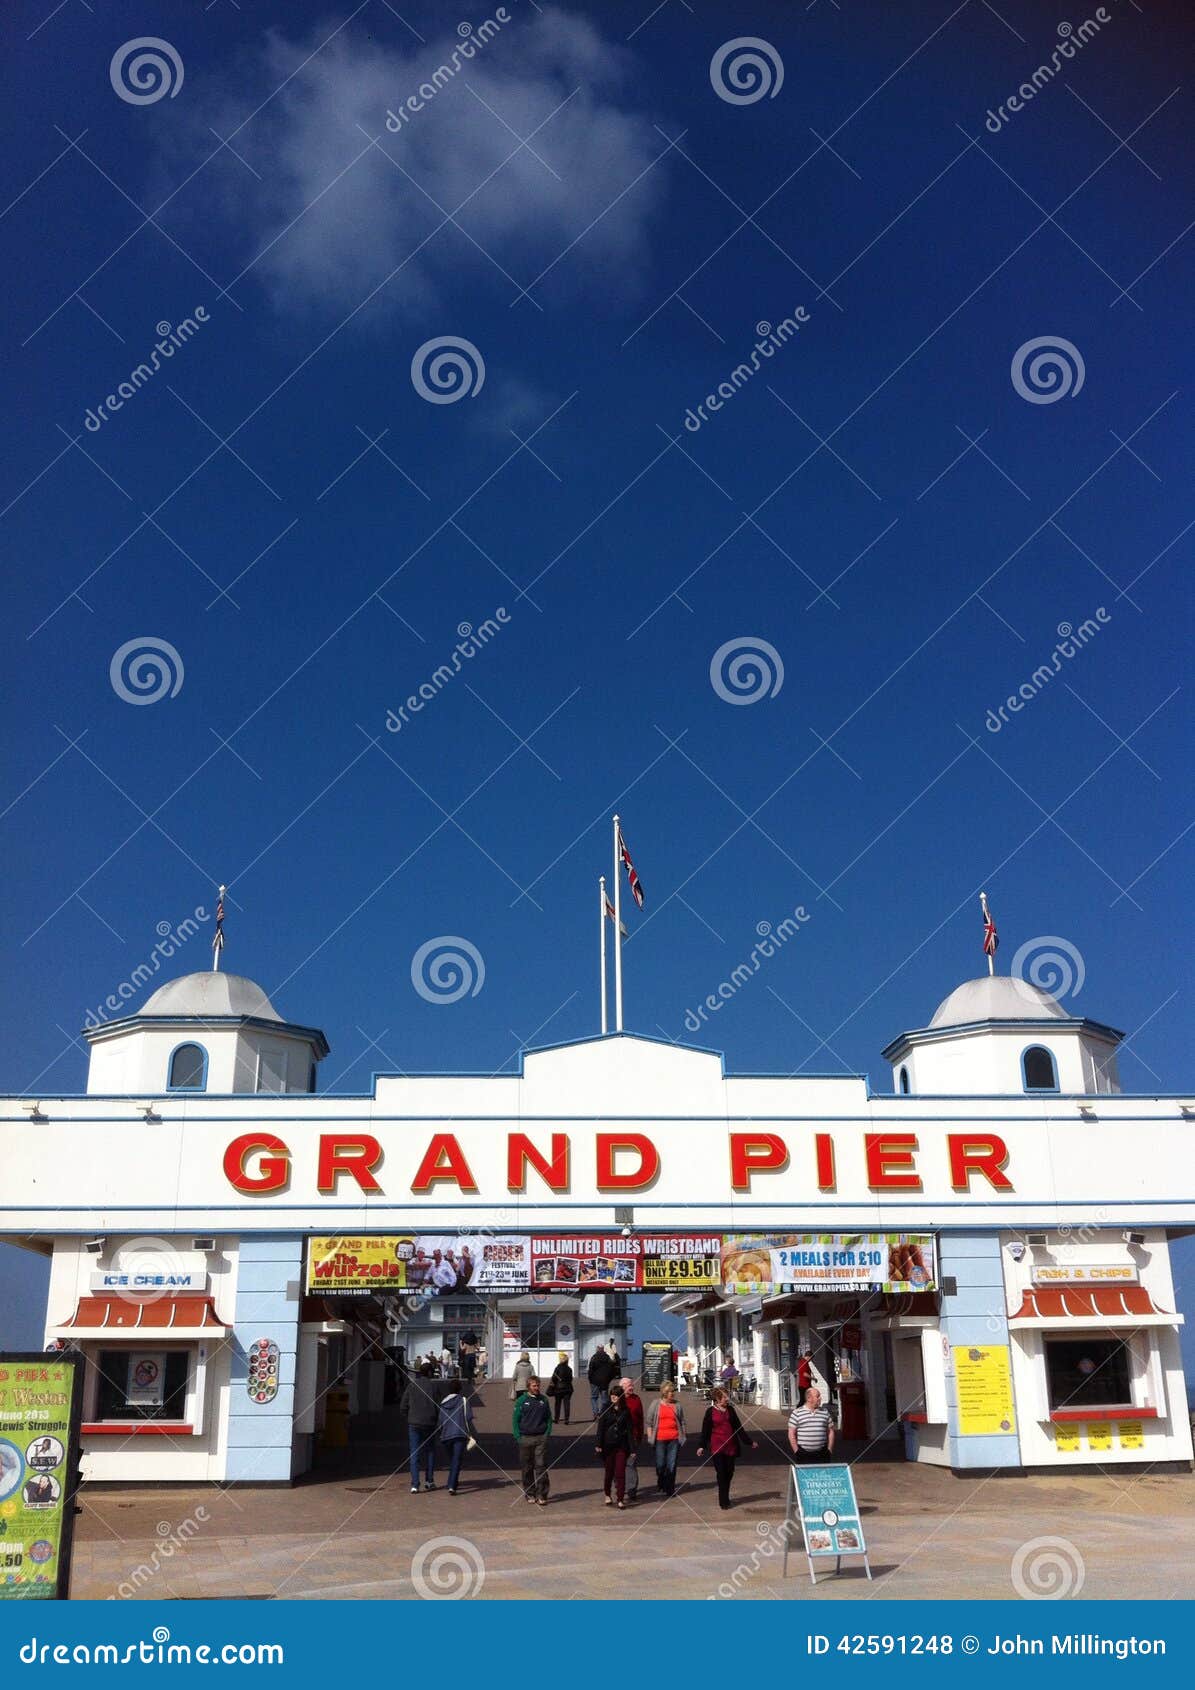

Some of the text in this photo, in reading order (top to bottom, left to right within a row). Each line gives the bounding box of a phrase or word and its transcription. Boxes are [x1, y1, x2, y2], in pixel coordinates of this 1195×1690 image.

[223, 1132, 1014, 1194] GRAND PIER
[325, 1240, 386, 1250] GRAND PIER
[532, 1239, 600, 1255] UNLIMITED
[603, 1239, 641, 1254] RIDES
[643, 1238, 721, 1254] WRISTBAND
[335, 1253, 358, 1265] The
[780, 1251, 881, 1266] 2 MEALS FOR £10
[314, 1259, 400, 1278] Wurzels
[646, 1267, 667, 1277] ONLY
[794, 1268, 871, 1278] AVAILABLE EVERY DAY
[1037, 1269, 1132, 1278] FISH & CHIPS
[512, 1270, 528, 1278] JUNE
[104, 1275, 191, 1286] ICE CREAM
[793, 1283, 870, 1292] WWW.GRANDPIER.CO.UK
[16, 1369, 48, 1381] PIER
[13, 1387, 68, 1407] Weston
[25, 1410, 50, 1420] 2013
[28, 1421, 67, 1431] Struggle
